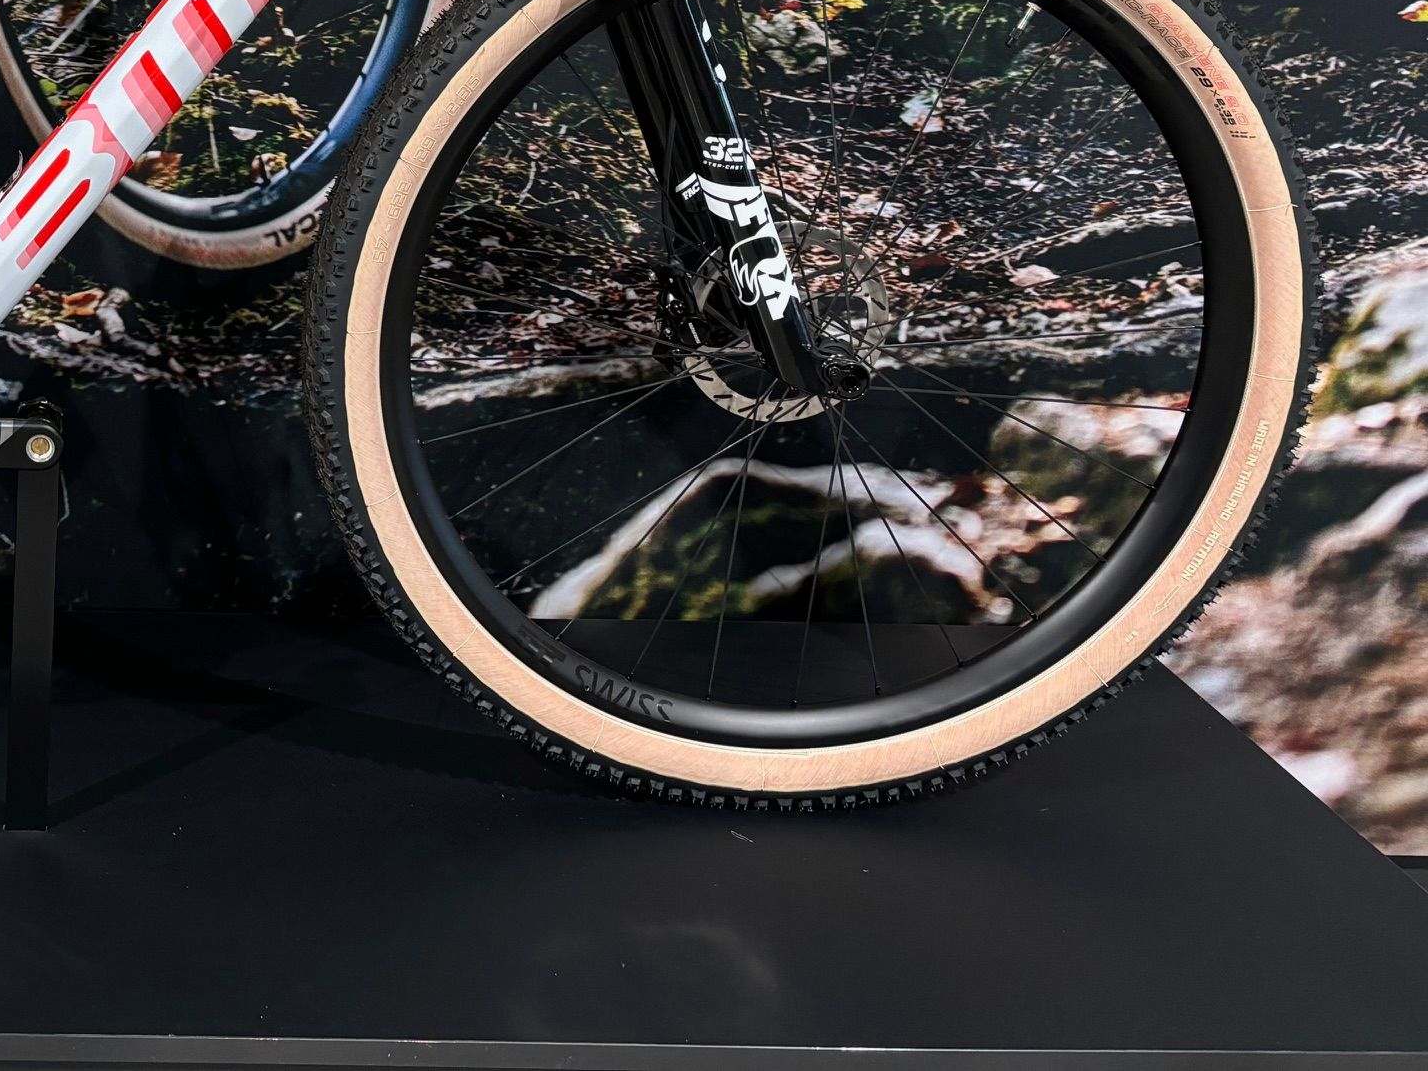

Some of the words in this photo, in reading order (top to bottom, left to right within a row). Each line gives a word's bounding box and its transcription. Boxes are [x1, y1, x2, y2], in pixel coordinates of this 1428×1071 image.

[1145, 2, 1229, 91] GRAPHENE
[1224, 95, 1249, 126] 2.0
[1190, 66, 1214, 88] 29
[1216, 98, 1237, 126] 2.35
[372, 236, 389, 263] 57
[387, 181, 412, 220] 622
[413, 136, 436, 163] 29
[444, 74, 481, 116] 2.35
[702, 135, 744, 163] 32
[1246, 453, 1261, 469] IN
[1251, 419, 1271, 451] MADE
[1219, 469, 1253, 522] THAILAND
[1180, 530, 1220, 582] ROTATION
[574, 664, 674, 724] SWISS
